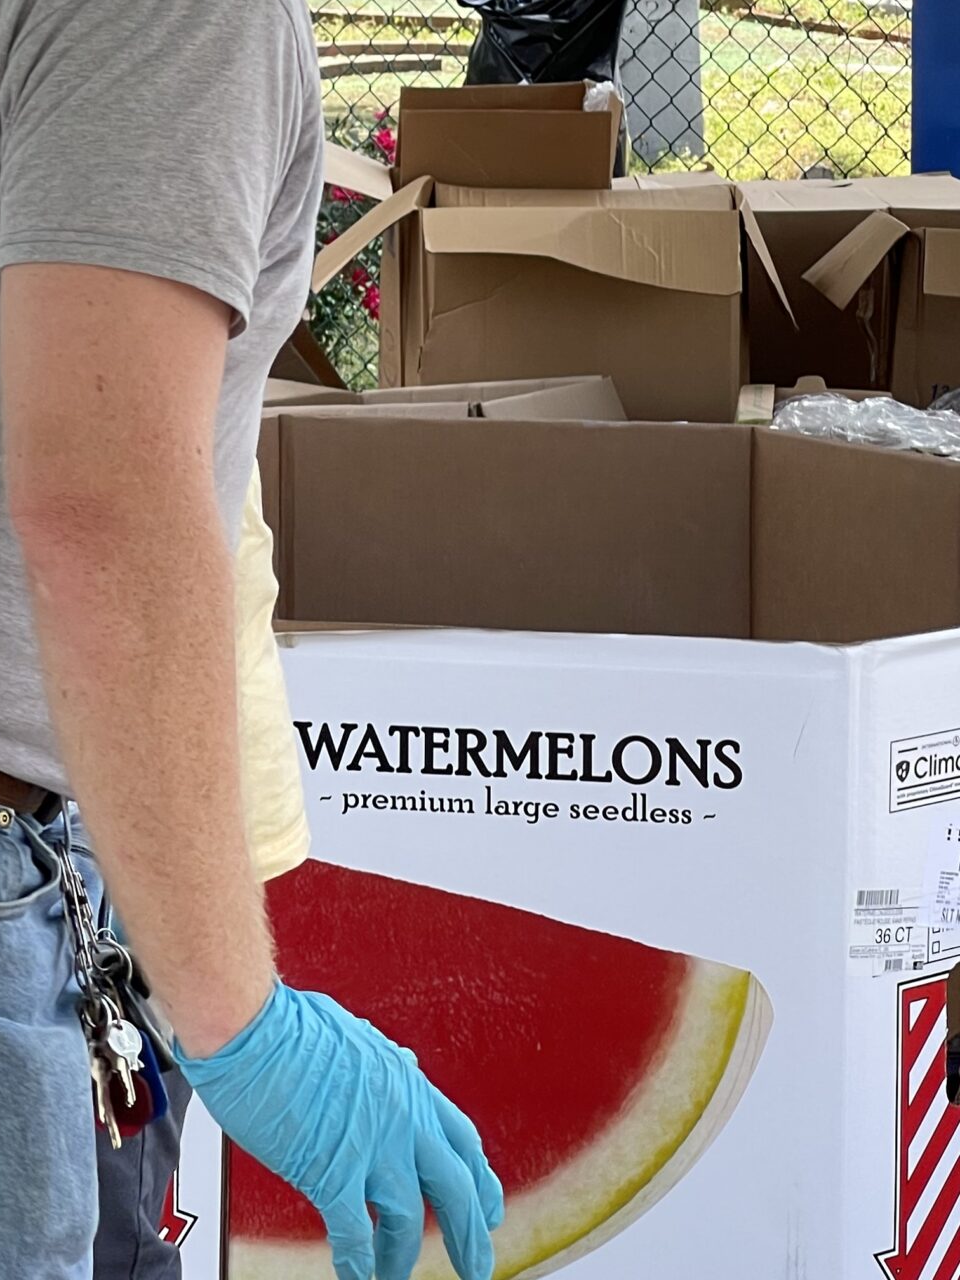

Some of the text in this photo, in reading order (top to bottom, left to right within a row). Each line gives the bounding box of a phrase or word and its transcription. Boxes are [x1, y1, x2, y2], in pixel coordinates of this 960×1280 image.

[293, 720, 743, 790] WATERMELONS
[342, 785, 693, 824] premium large seedless
[875, 925, 913, 944] 36 CT
